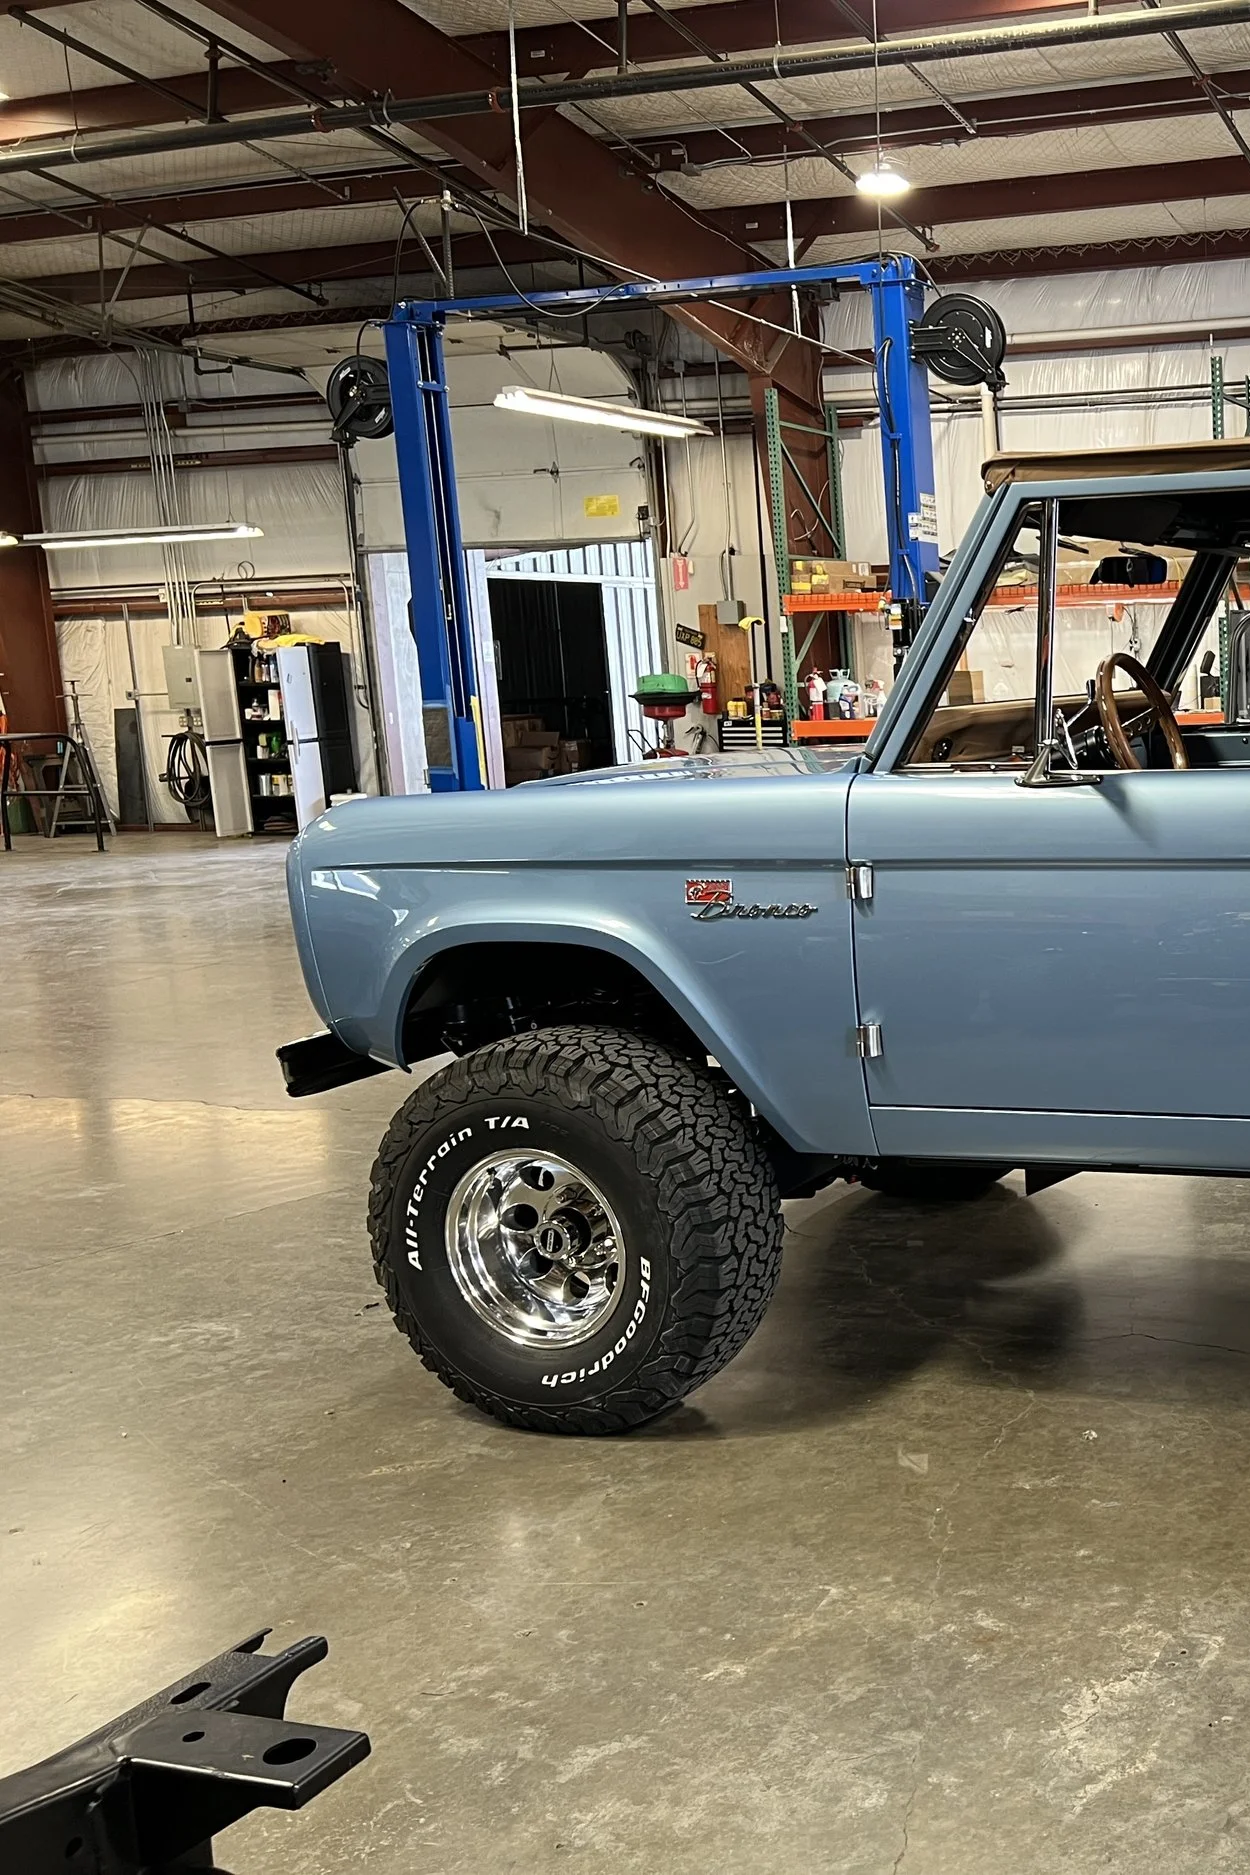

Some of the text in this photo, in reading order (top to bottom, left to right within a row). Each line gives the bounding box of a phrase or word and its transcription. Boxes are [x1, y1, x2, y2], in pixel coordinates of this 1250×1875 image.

[690, 890, 818, 919] Bronco
[406, 1115, 531, 1271] All-Terrain T/A
[541, 1256, 651, 1388] BFGoodrich
